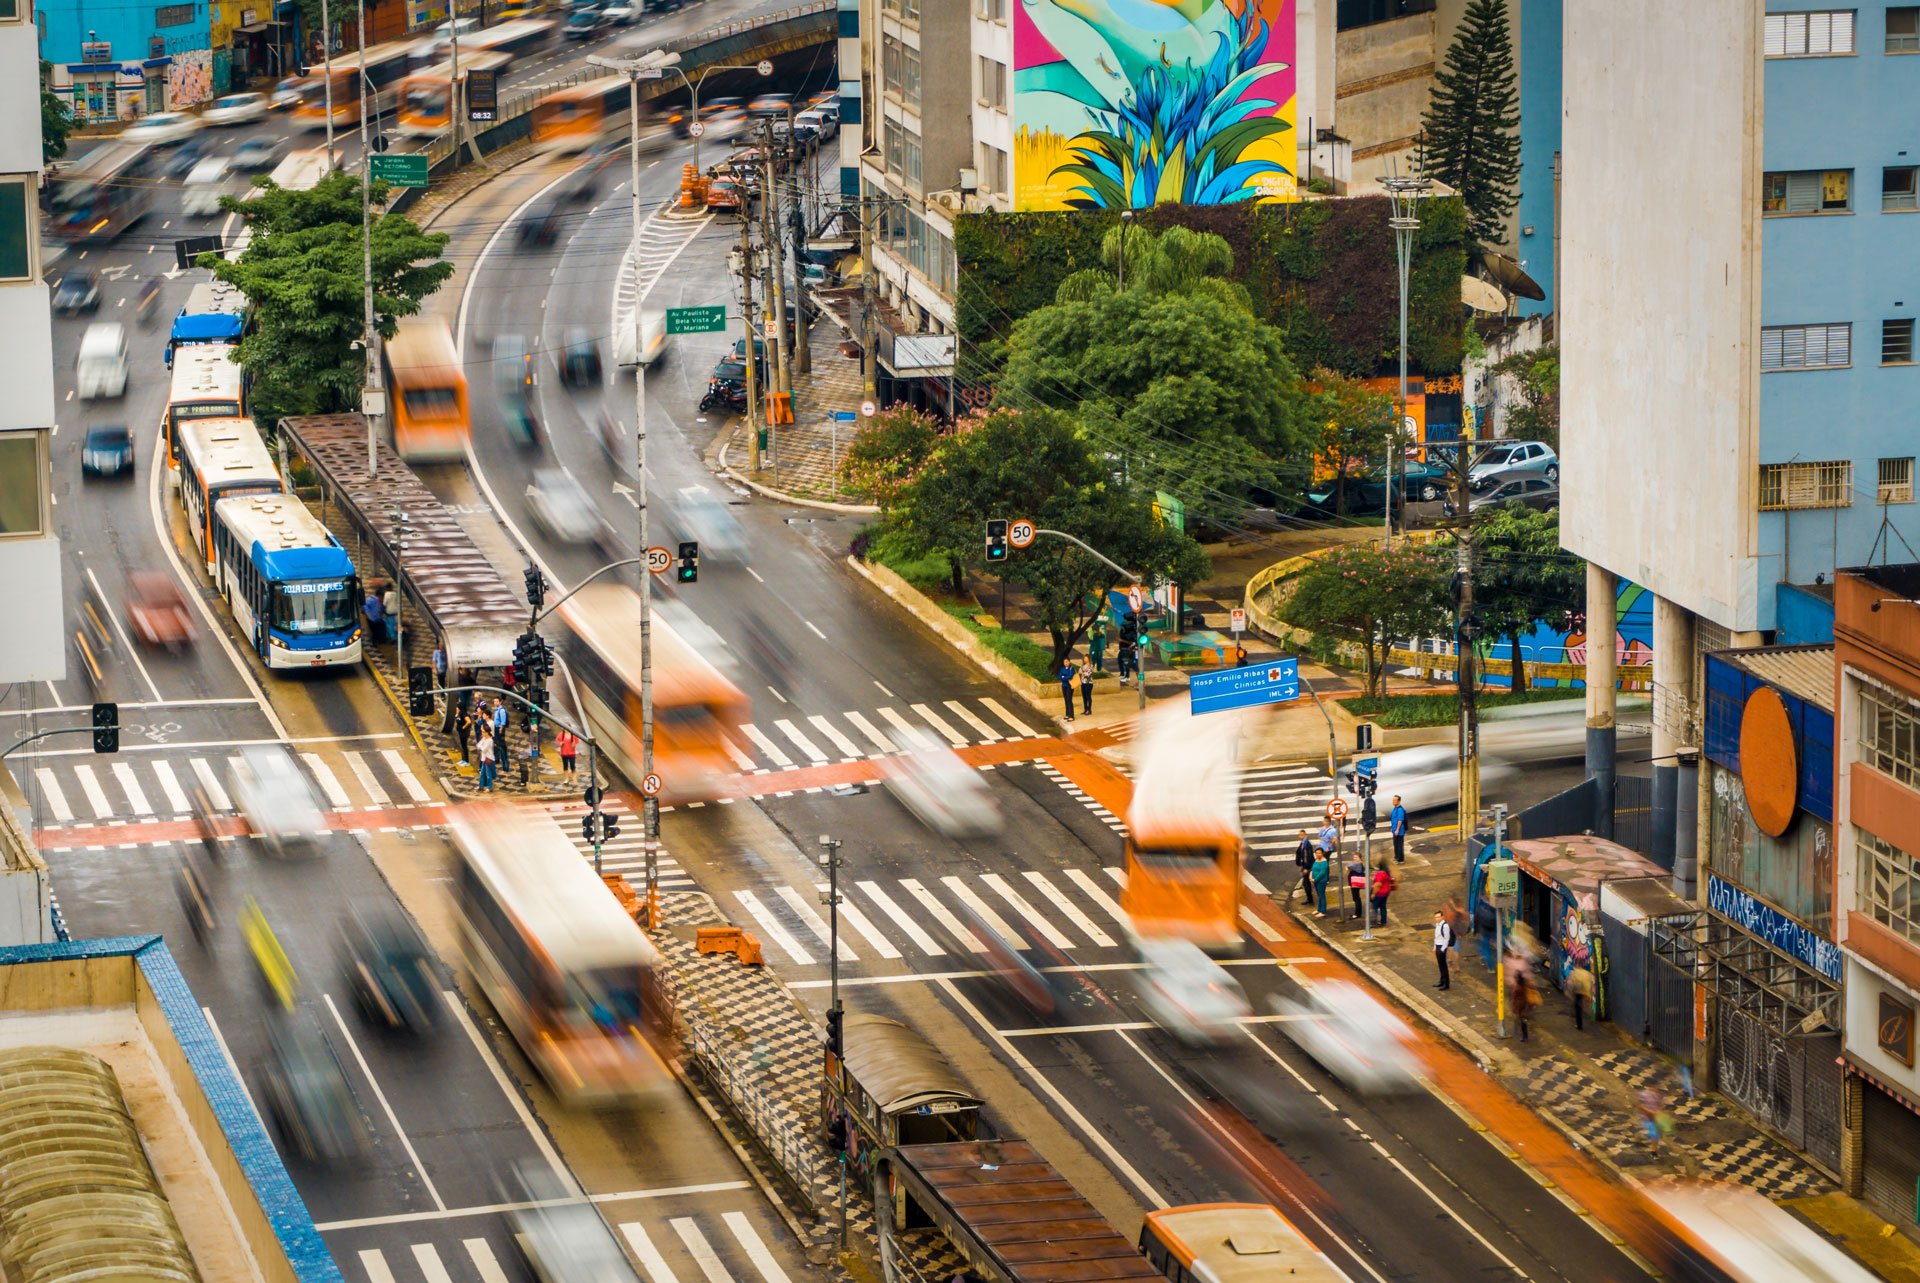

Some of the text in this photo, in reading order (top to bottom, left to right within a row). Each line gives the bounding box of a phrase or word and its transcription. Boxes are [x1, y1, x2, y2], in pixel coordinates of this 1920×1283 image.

[1013, 525, 1031, 539] 50
[648, 552, 668, 565] 50
[301, 584, 316, 593] EDU
[317, 581, 344, 592] CHAVES
[1193, 679, 1213, 687] Hosp
[1243, 670, 1266, 679] Ribas
[1268, 690, 1283, 698] IML
